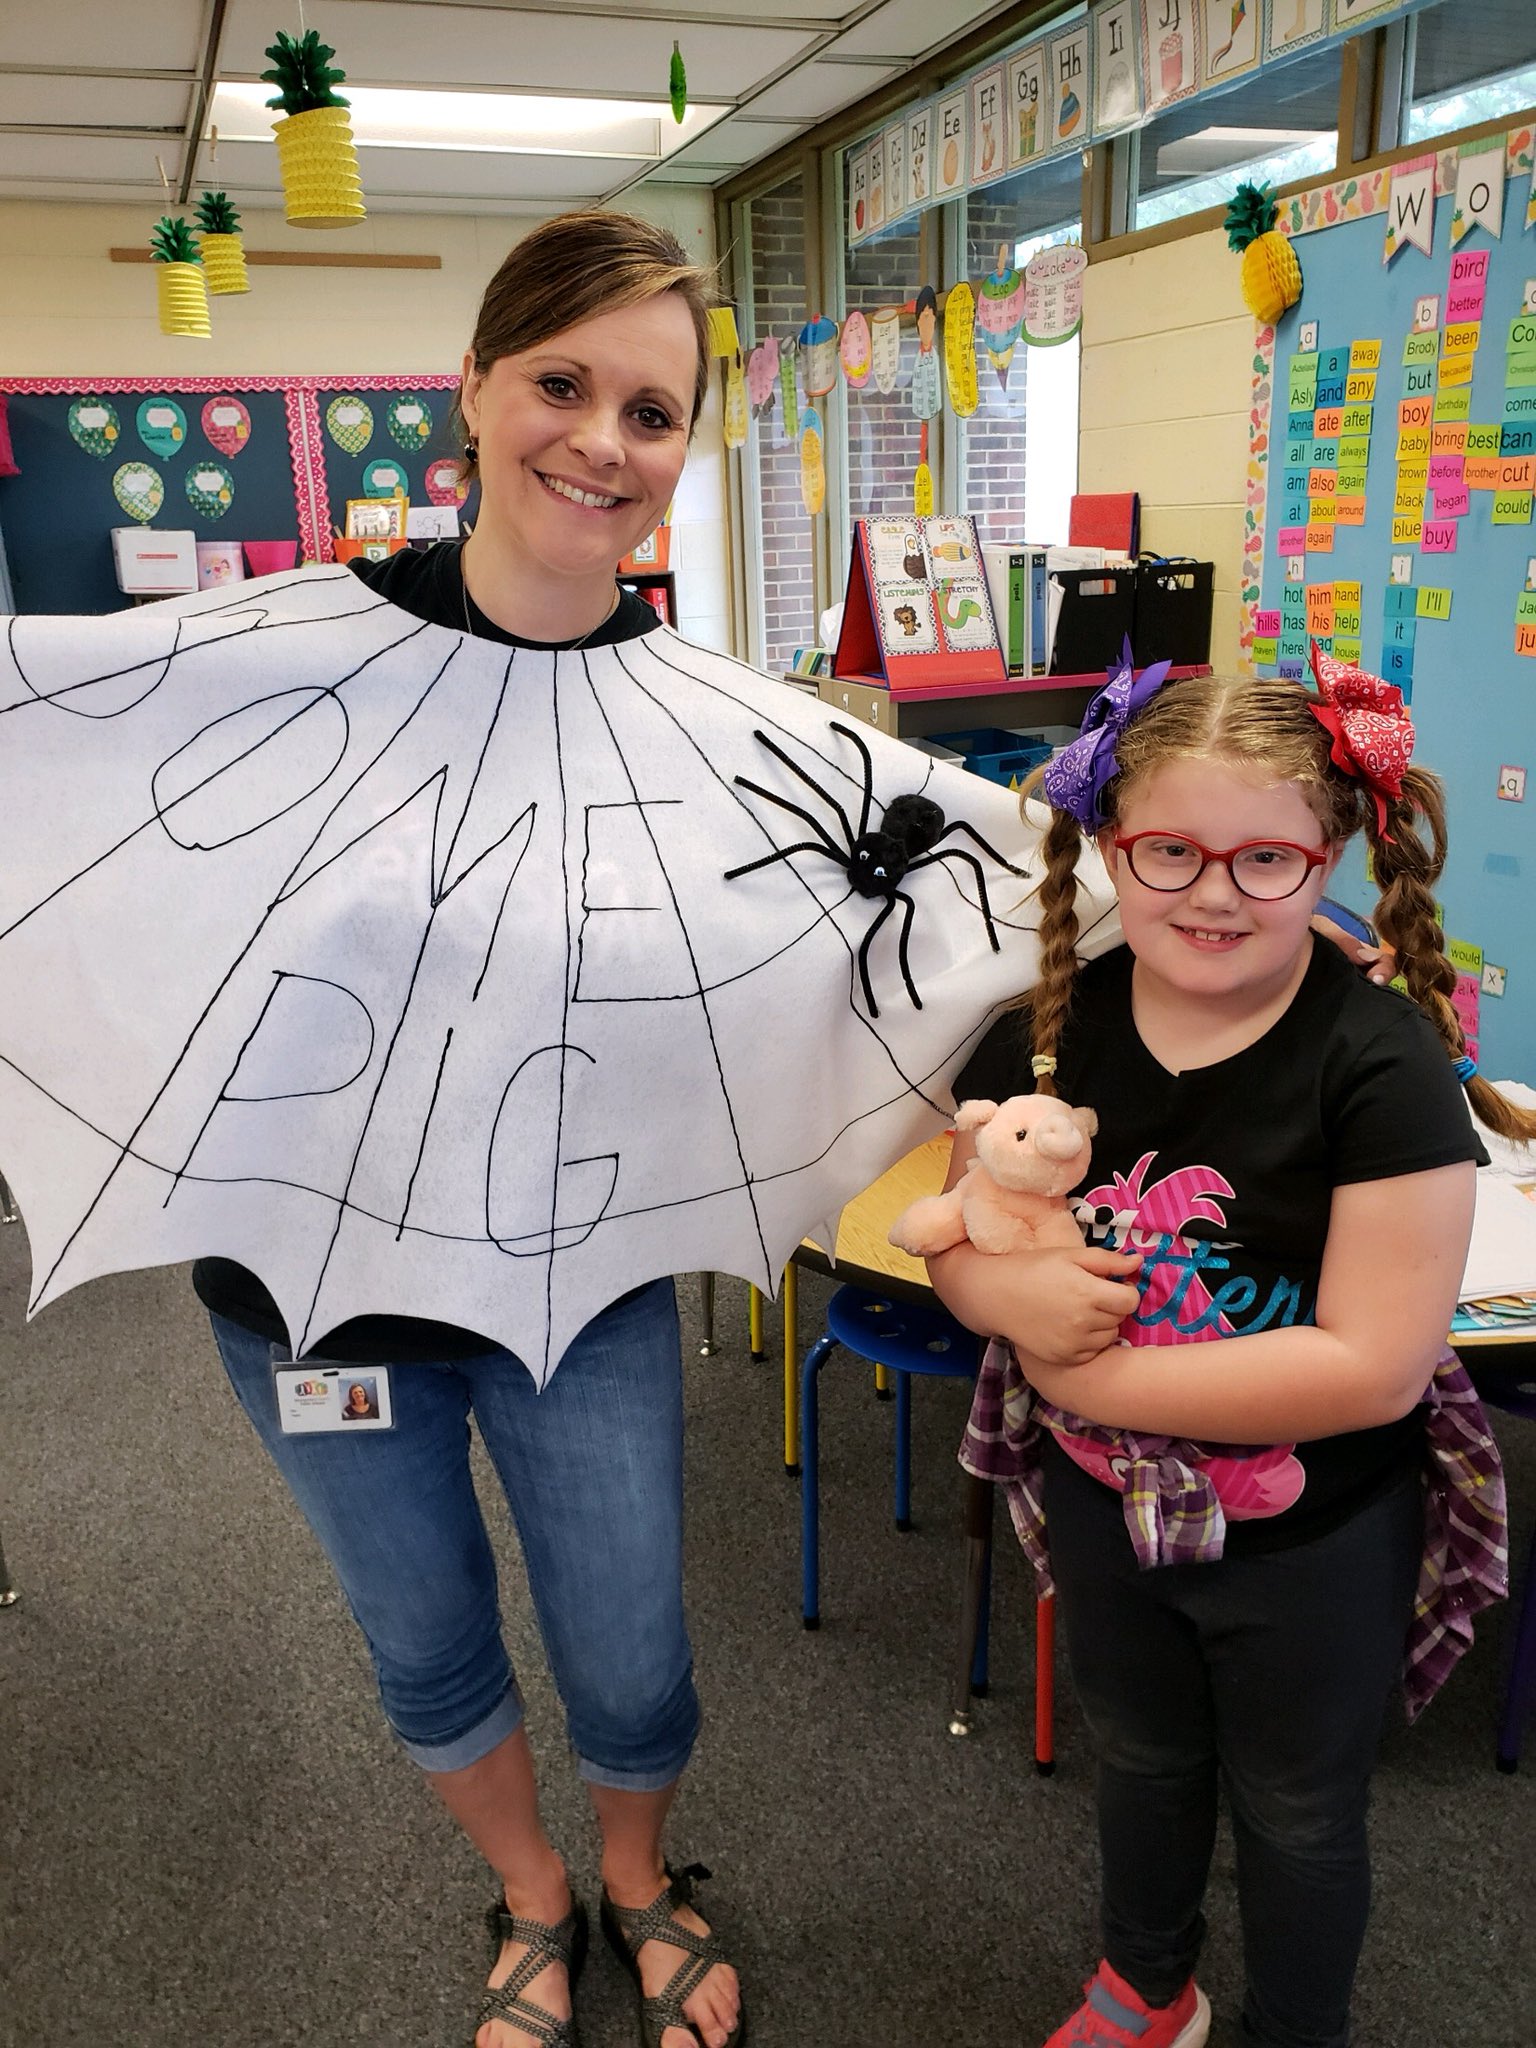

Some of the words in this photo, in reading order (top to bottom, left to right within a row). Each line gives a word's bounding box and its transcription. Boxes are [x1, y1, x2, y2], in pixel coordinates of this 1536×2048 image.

[1060, 45, 1081, 82] Hh
[1017, 69, 1038, 102] Gg
[980, 84, 996, 120] Ff
[944, 109, 960, 139] Ee
[912, 120, 926, 152] Dd
[1397, 187, 1427, 227] W
[1469, 182, 1490, 213] O
[1453, 256, 1485, 280] bird
[1449, 297, 1482, 312] better
[1421, 305, 1431, 322] b
[1446, 331, 1478, 347] been
[1512, 324, 1536, 343] Co
[1352, 349, 1379, 364] away
[1407, 341, 1437, 355] Brody
[1328, 357, 1337, 371] a
[1440, 364, 1471, 378] because
[1408, 369, 1432, 391] but
[1291, 388, 1315, 407] Asly
[1318, 381, 1343, 402] and
[1348, 380, 1374, 400] any
[1437, 400, 1468, 411] birthday
[1318, 414, 1339, 431] ate
[1344, 411, 1370, 427] after
[1402, 405, 1430, 426] boy
[1289, 419, 1314, 432] Anna
[1400, 435, 1429, 453] baby
[1435, 431, 1465, 449] bring
[1467, 430, 1499, 449] best
[1502, 431, 1532, 449] can
[1290, 444, 1305, 461] all
[1314, 447, 1335, 461] are
[1340, 446, 1367, 459] always
[1399, 466, 1427, 478] brown
[1431, 466, 1461, 478] before
[1466, 466, 1499, 478] brother
[1503, 462, 1529, 483] cut
[1287, 476, 1305, 490] am
[1310, 474, 1335, 492] also
[1339, 474, 1365, 489] again
[1396, 494, 1424, 507] black
[1436, 495, 1467, 509] began
[1496, 500, 1529, 514] could
[1289, 504, 1301, 521] at
[1311, 503, 1336, 516] about
[1338, 505, 1364, 516] around
[1394, 520, 1421, 538] blue
[1307, 531, 1332, 546] again
[1425, 528, 1453, 549] buy
[1284, 586, 1304, 603] hot
[1309, 590, 1331, 606] him
[1335, 589, 1359, 602] hand
[1426, 591, 1442, 611] I'll
[1257, 616, 1280, 631] hills
[1283, 613, 1305, 630] has
[1312, 612, 1330, 631] his
[1335, 613, 1359, 633] help
[1394, 621, 1404, 640] it
[1282, 641, 1304, 655] here
[1335, 646, 1360, 658] house
[1391, 651, 1403, 668] is
[1280, 667, 1303, 679] have
[1506, 776, 1519, 797] q
[1451, 947, 1480, 966] would
[1488, 972, 1496, 986] x
[162, 970, 620, 1258] PIG
